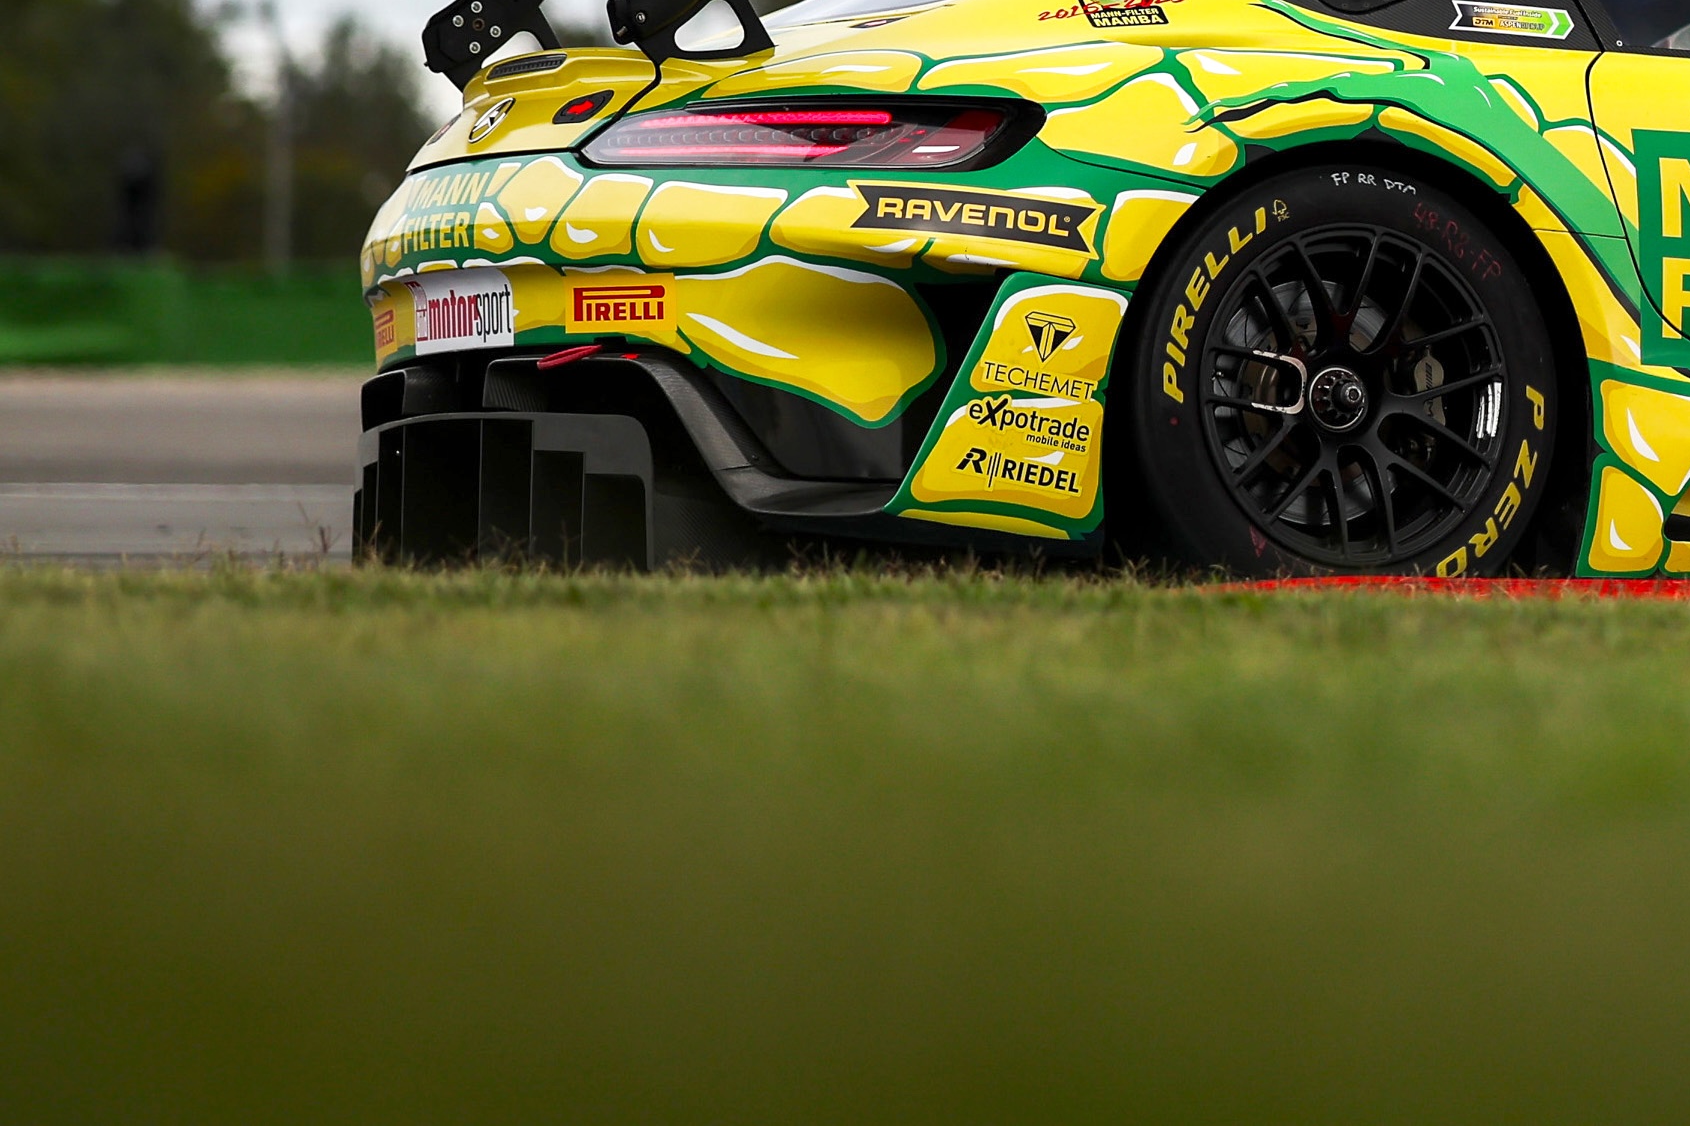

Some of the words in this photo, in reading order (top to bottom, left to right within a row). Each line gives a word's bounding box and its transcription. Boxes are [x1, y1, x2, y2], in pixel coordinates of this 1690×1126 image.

[1090, 7, 1159, 20] MANN-FILTER
[1093, 16, 1165, 27] MAMBA
[1474, 18, 1494, 26] DTM
[1383, 178, 1417, 196] DTM
[403, 211, 471, 254] FILTER
[428, 284, 512, 343] motorsport
[573, 285, 665, 322] PIRELLI
[1163, 206, 1266, 404] PIRELLI
[984, 361, 1095, 401] TECHEMET
[969, 398, 1090, 443] eXpotrade
[1526, 385, 1545, 431] P
[1026, 433, 1059, 447] mobile
[1061, 438, 1087, 453] ideas
[1001, 458, 1079, 493] RIEDEL
[1436, 439, 1538, 578] ZERO
